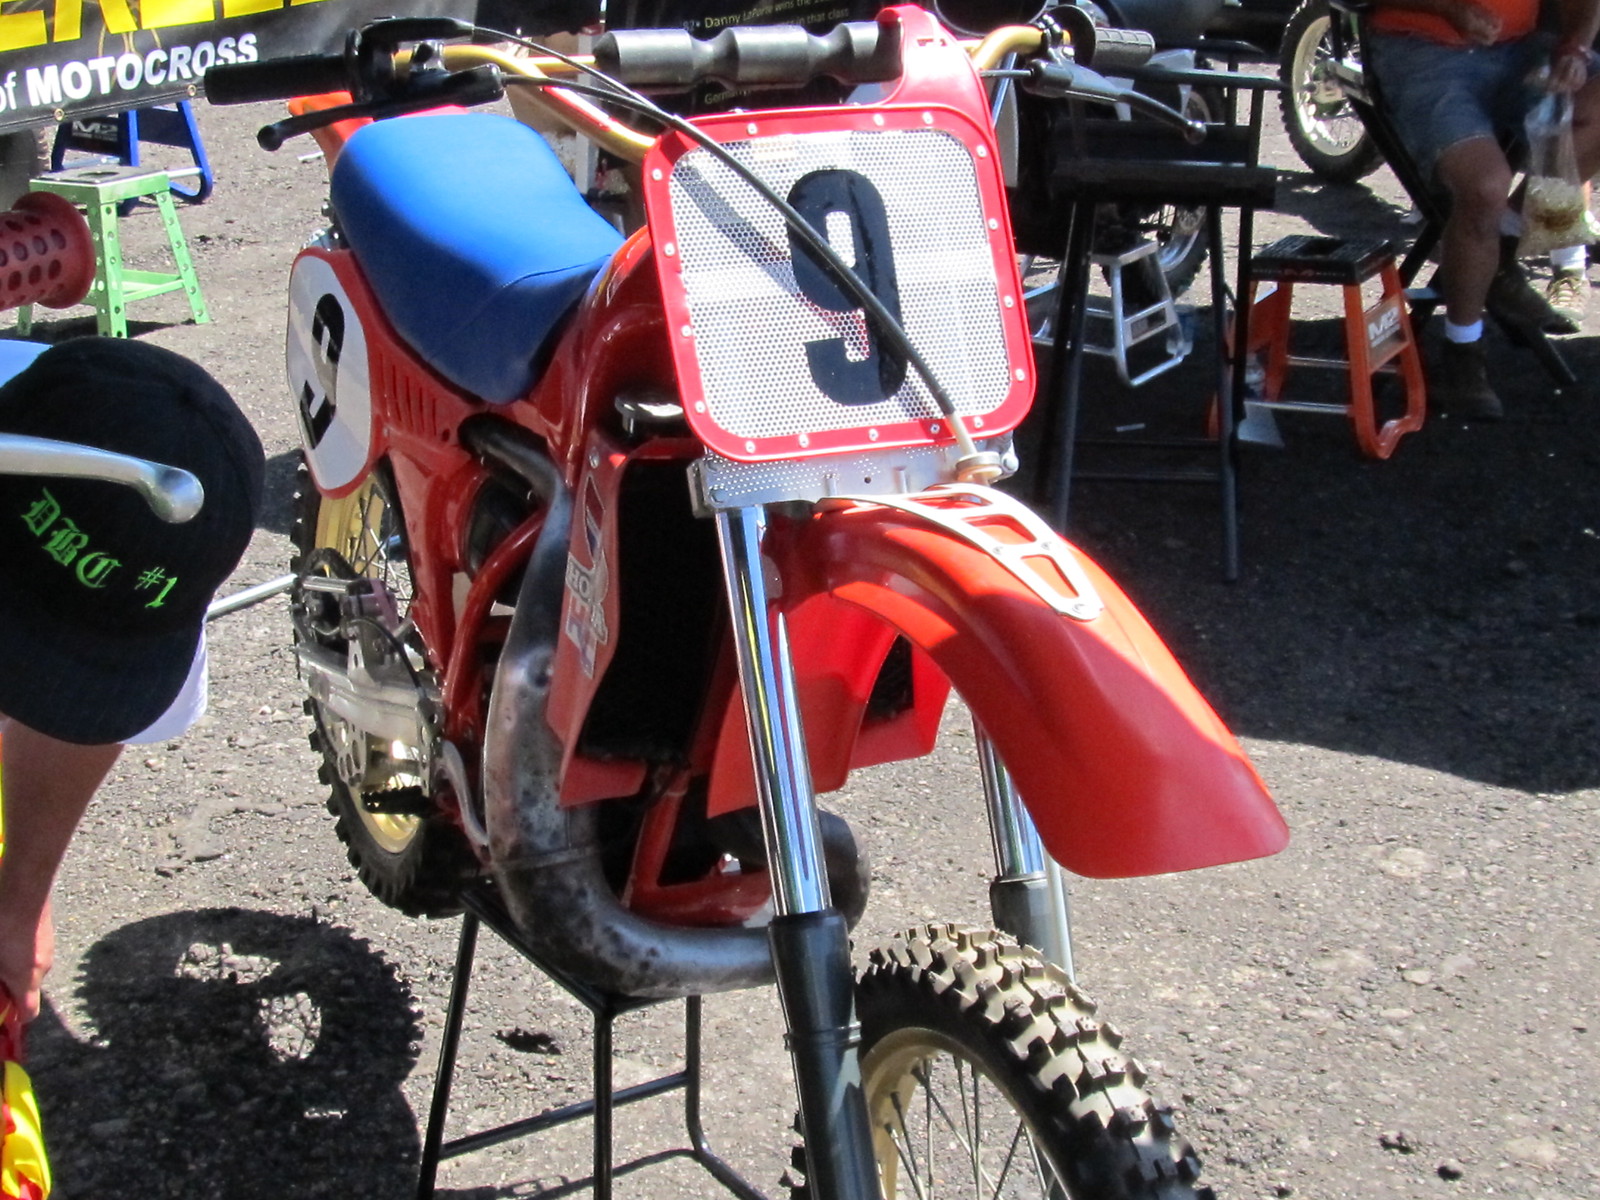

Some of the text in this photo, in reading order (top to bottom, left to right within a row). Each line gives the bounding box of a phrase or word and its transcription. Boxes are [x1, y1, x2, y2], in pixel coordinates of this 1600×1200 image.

[704, 15, 741, 28] Danny
[807, 13, 826, 24] that
[26, 33, 259, 106] MOTOCROSS
[786, 168, 908, 407] 9
[134, 566, 178, 608] #1
